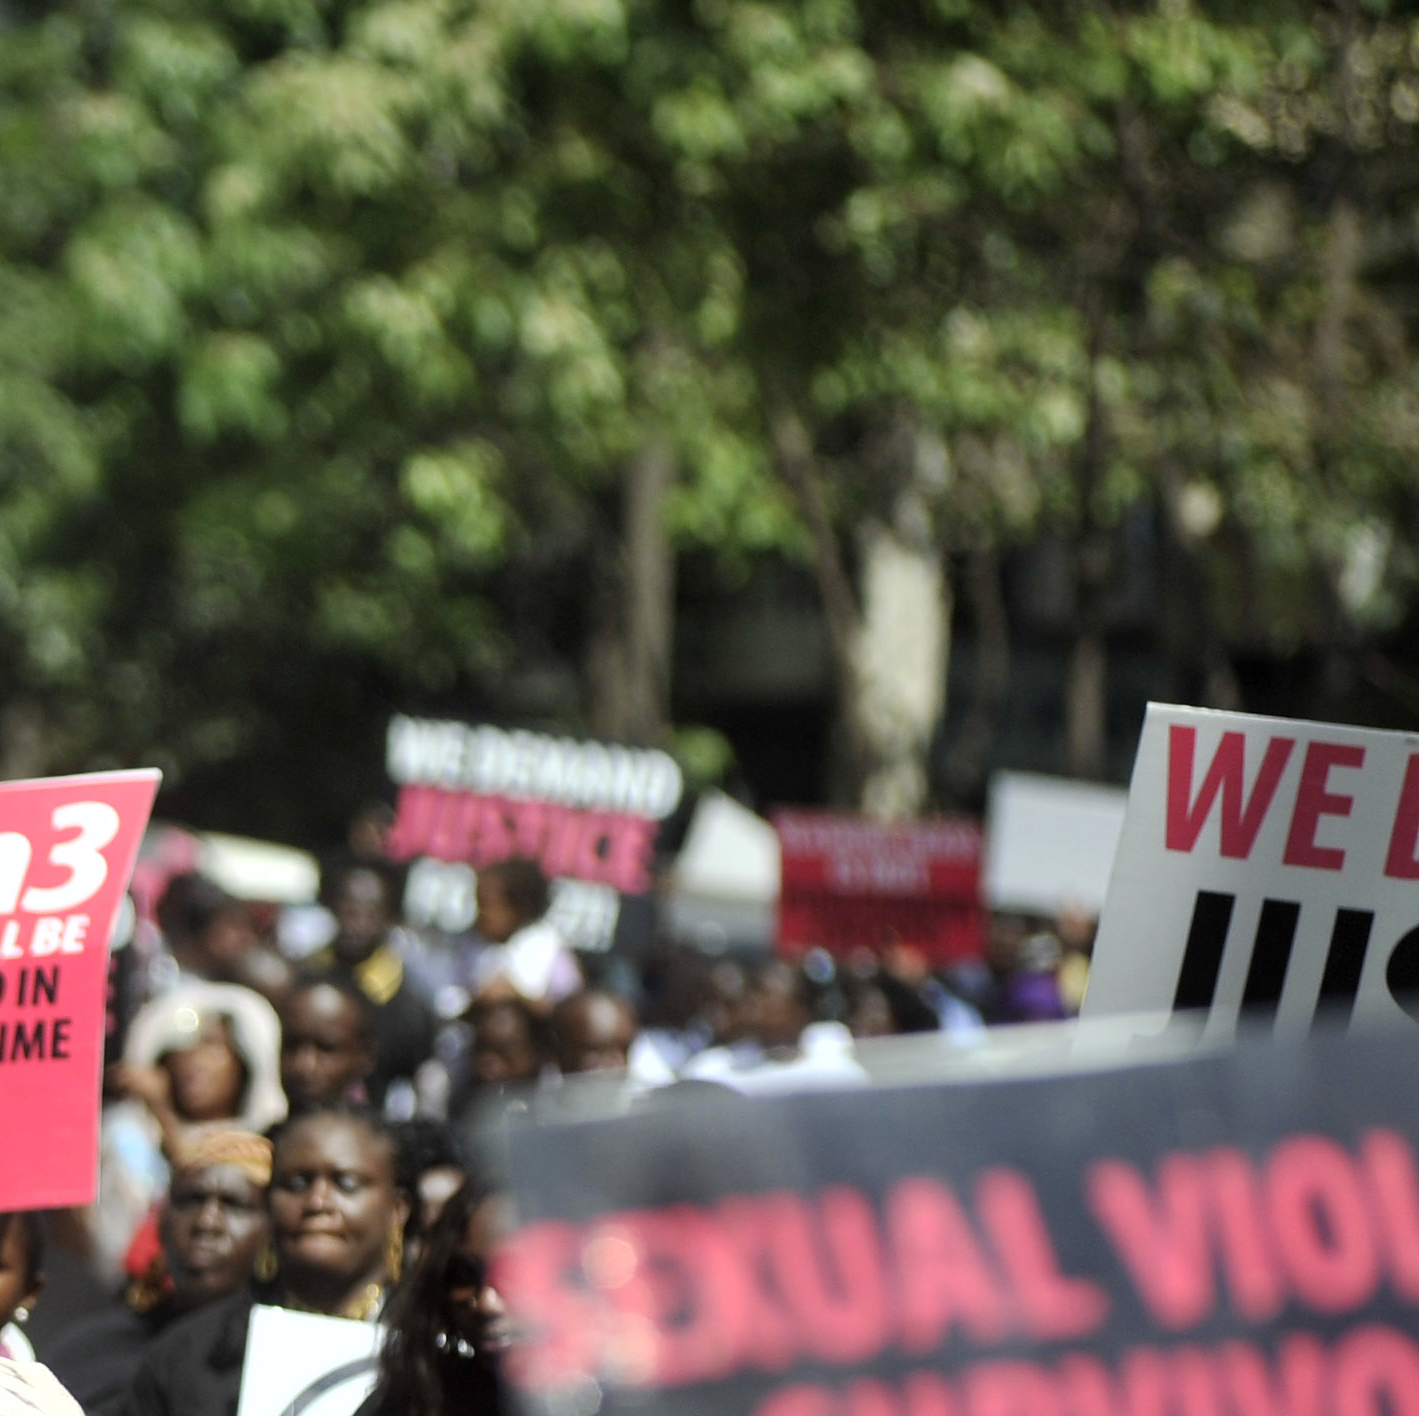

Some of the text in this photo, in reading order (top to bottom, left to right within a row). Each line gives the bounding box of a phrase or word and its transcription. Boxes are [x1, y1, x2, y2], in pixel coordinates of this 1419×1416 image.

[1165, 724, 1367, 871] WE
[30, 914, 91, 957] BE
[16, 964, 60, 1007] IN
